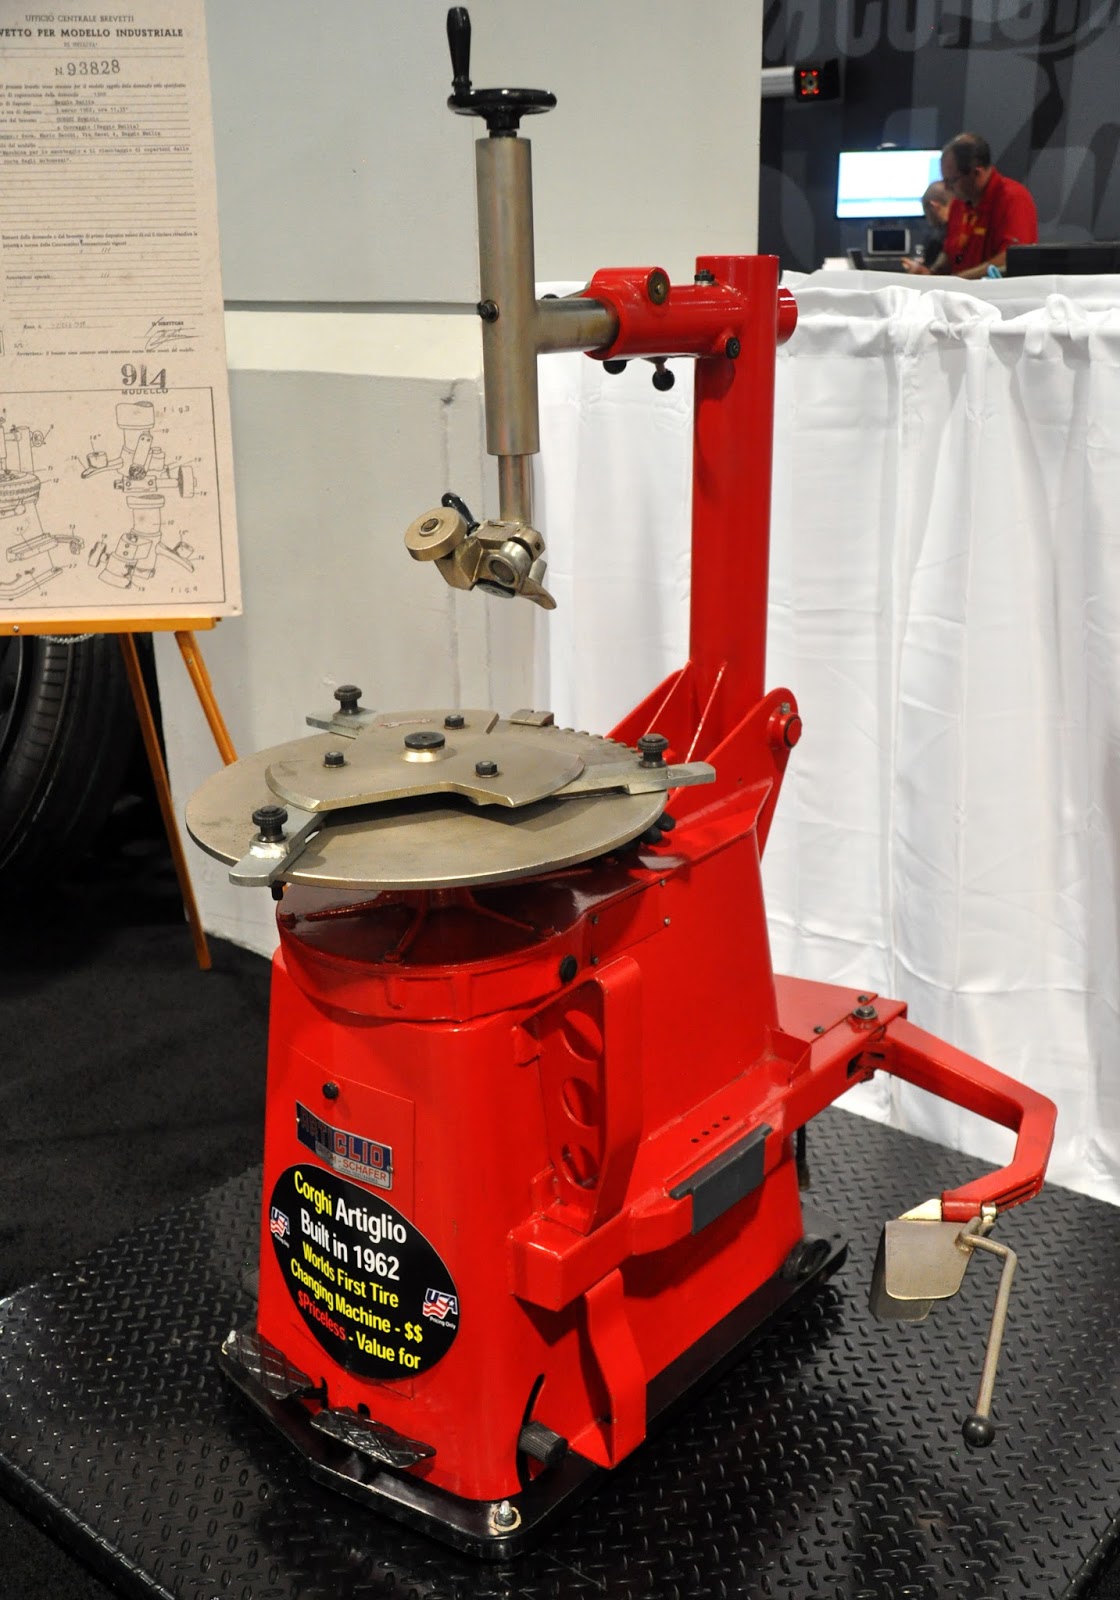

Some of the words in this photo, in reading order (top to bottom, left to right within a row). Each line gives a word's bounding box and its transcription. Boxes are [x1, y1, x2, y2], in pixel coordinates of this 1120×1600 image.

[37, 28, 56, 37] PER
[60, 28, 110, 37] MODELLO
[116, 28, 183, 37] INDUSTRIALE
[67, 59, 121, 76] 93828
[121, 363, 167, 389] 914
[343, 1159, 387, 1182] SCHAFER
[294, 1170, 333, 1216] Corghi
[335, 1197, 407, 1244] Artiglio
[301, 1207, 331, 1253] Built
[333, 1232, 348, 1263] in
[353, 1245, 400, 1281] 1962
[302, 1241, 336, 1282] Worlds
[337, 1268, 367, 1298] First
[369, 1282, 399, 1308] Tire
[291, 1258, 334, 1312] Changing
[335, 1293, 391, 1333] Machine
[404, 1321, 424, 1344] $$
[422, 1288, 458, 1320] USA
[355, 1330, 395, 1362] Value
[398, 1347, 421, 1370] for
